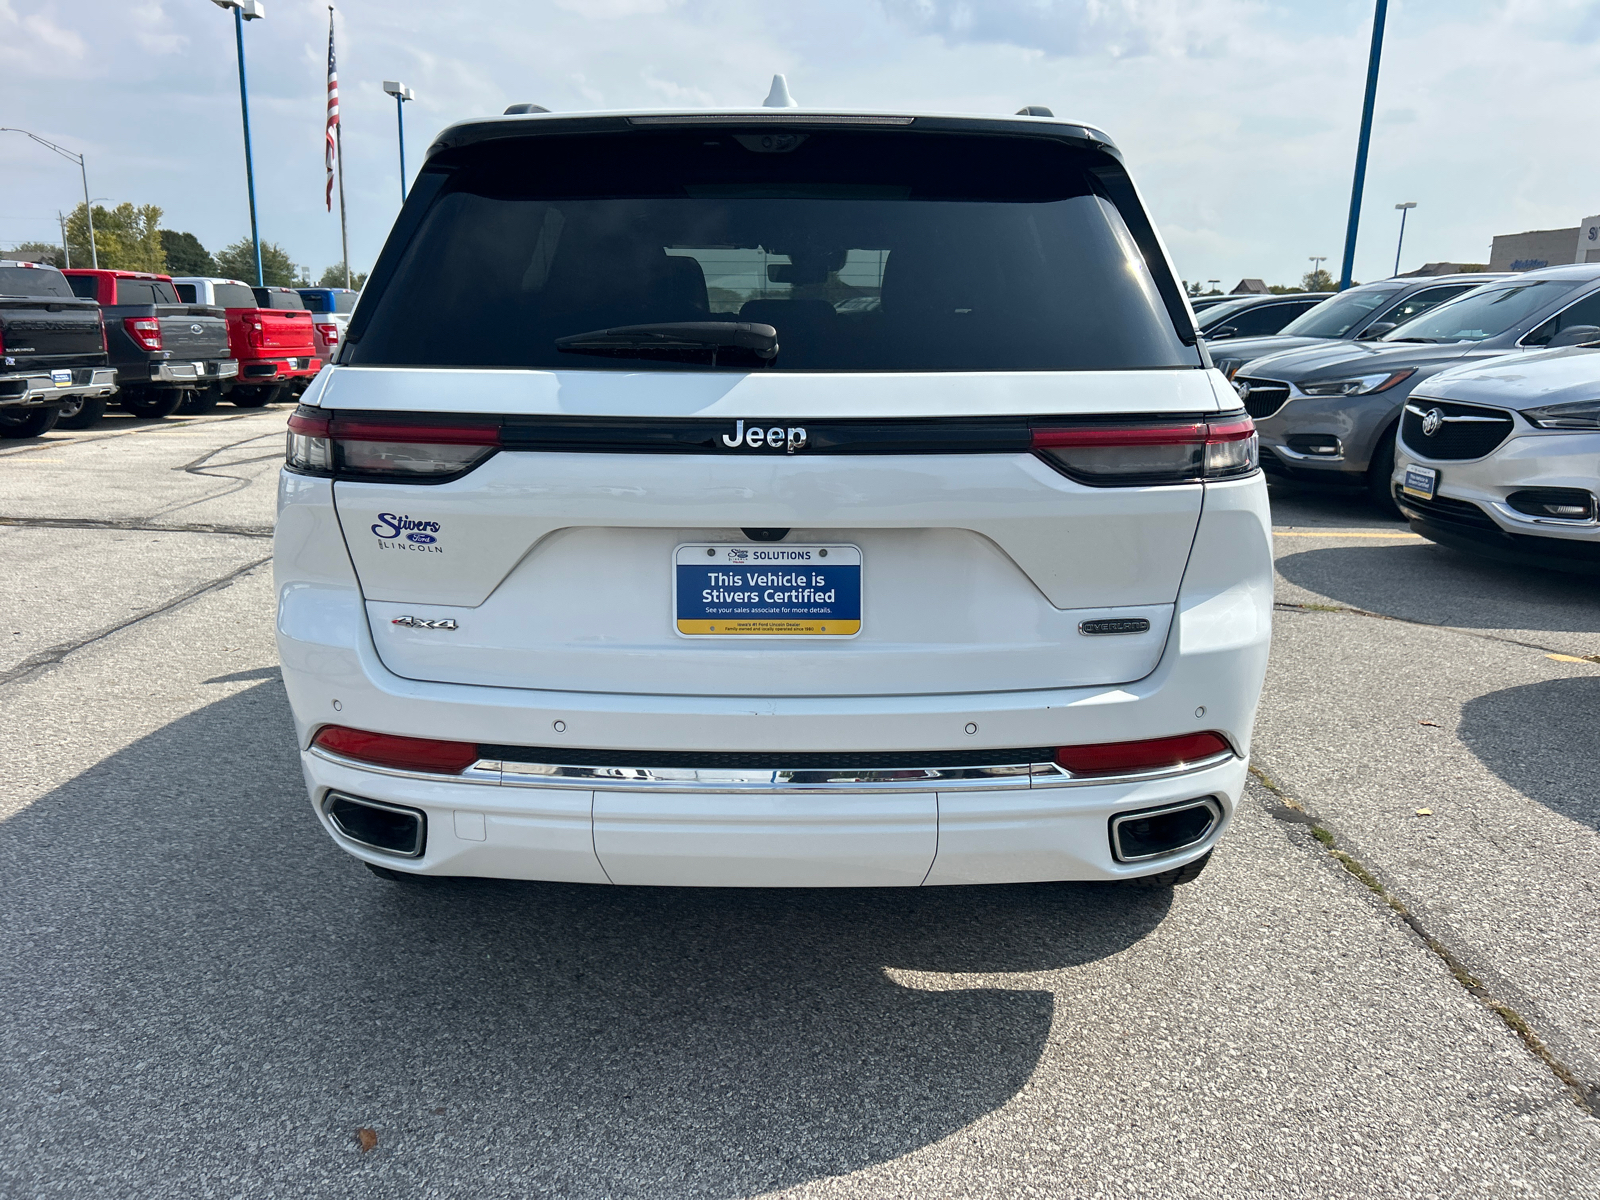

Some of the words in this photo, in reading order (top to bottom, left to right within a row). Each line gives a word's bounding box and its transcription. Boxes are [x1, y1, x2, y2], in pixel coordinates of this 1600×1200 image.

[722, 419, 807, 454] Jeep
[371, 512, 441, 539] Stivers
[412, 534, 431, 543] Ford
[383, 541, 443, 553] LINCOLN
[753, 551, 811, 560] SOLUTIONS
[707, 572, 742, 587] This
[746, 572, 807, 587] Vehicle
[811, 572, 825, 587] is
[702, 589, 759, 603] Stivers
[763, 589, 835, 603] Certified
[1084, 621, 1147, 631] OVERLAND
